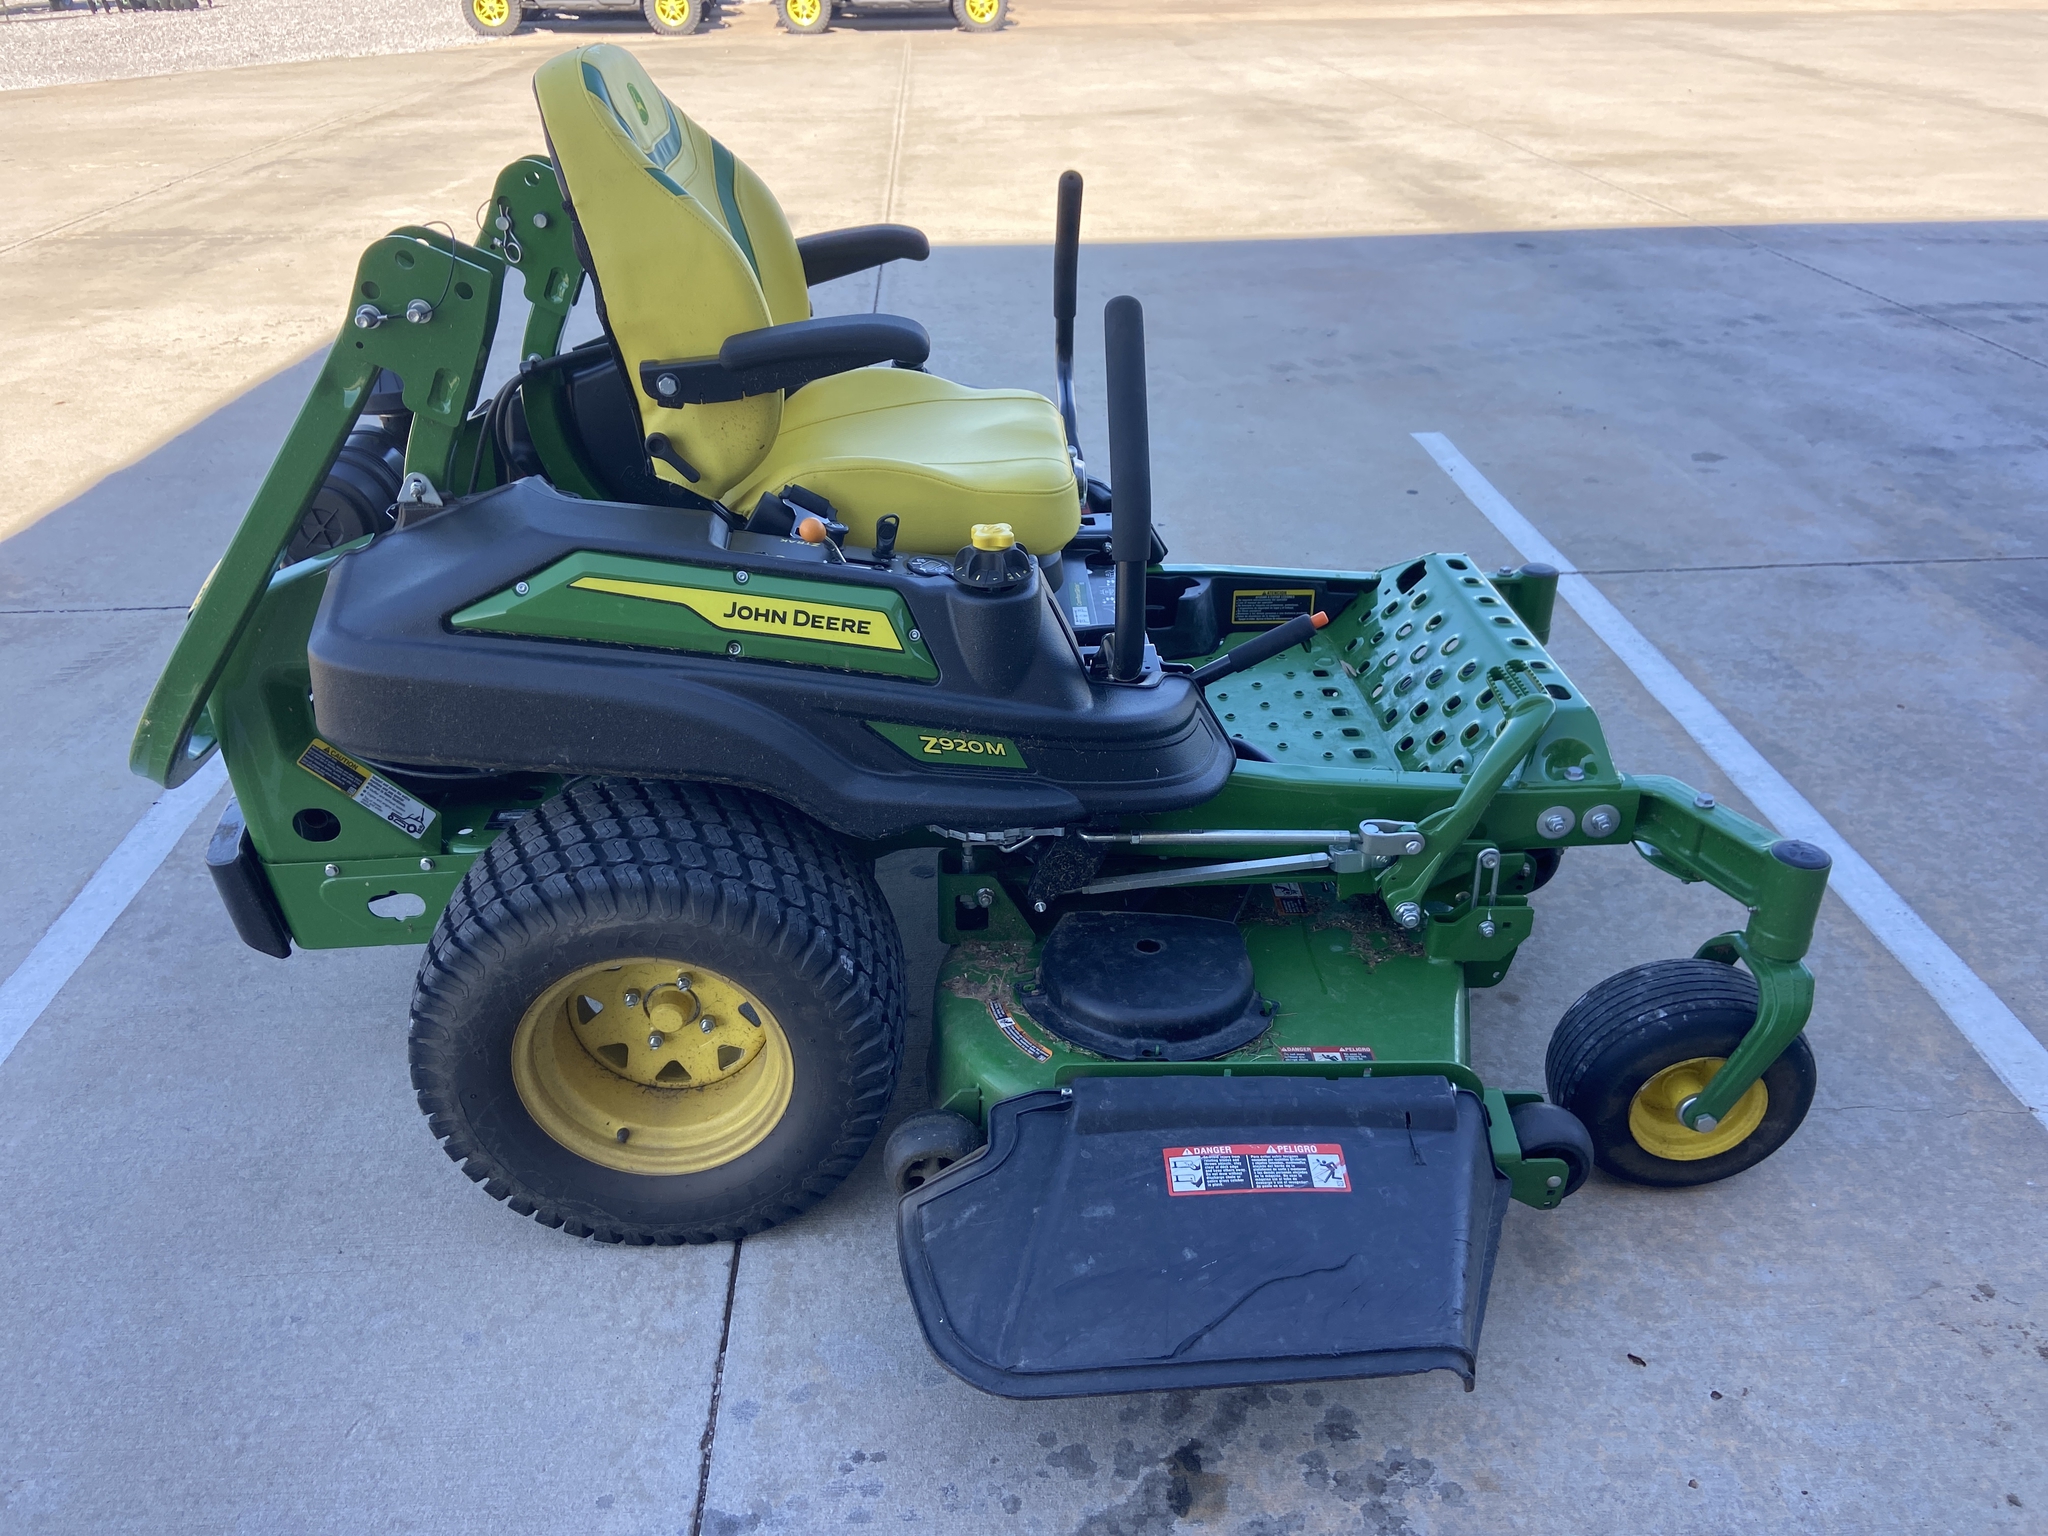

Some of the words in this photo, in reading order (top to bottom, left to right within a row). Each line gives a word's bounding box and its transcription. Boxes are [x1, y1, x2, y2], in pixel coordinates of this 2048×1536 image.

[723, 601, 787, 625] JOHN
[793, 609, 871, 635] DEERE
[918, 735, 1007, 756] Z920M
[330, 750, 359, 771] CAUTION
[1194, 1146, 1232, 1155] DANGER
[1277, 1144, 1318, 1154] PELIGRO
